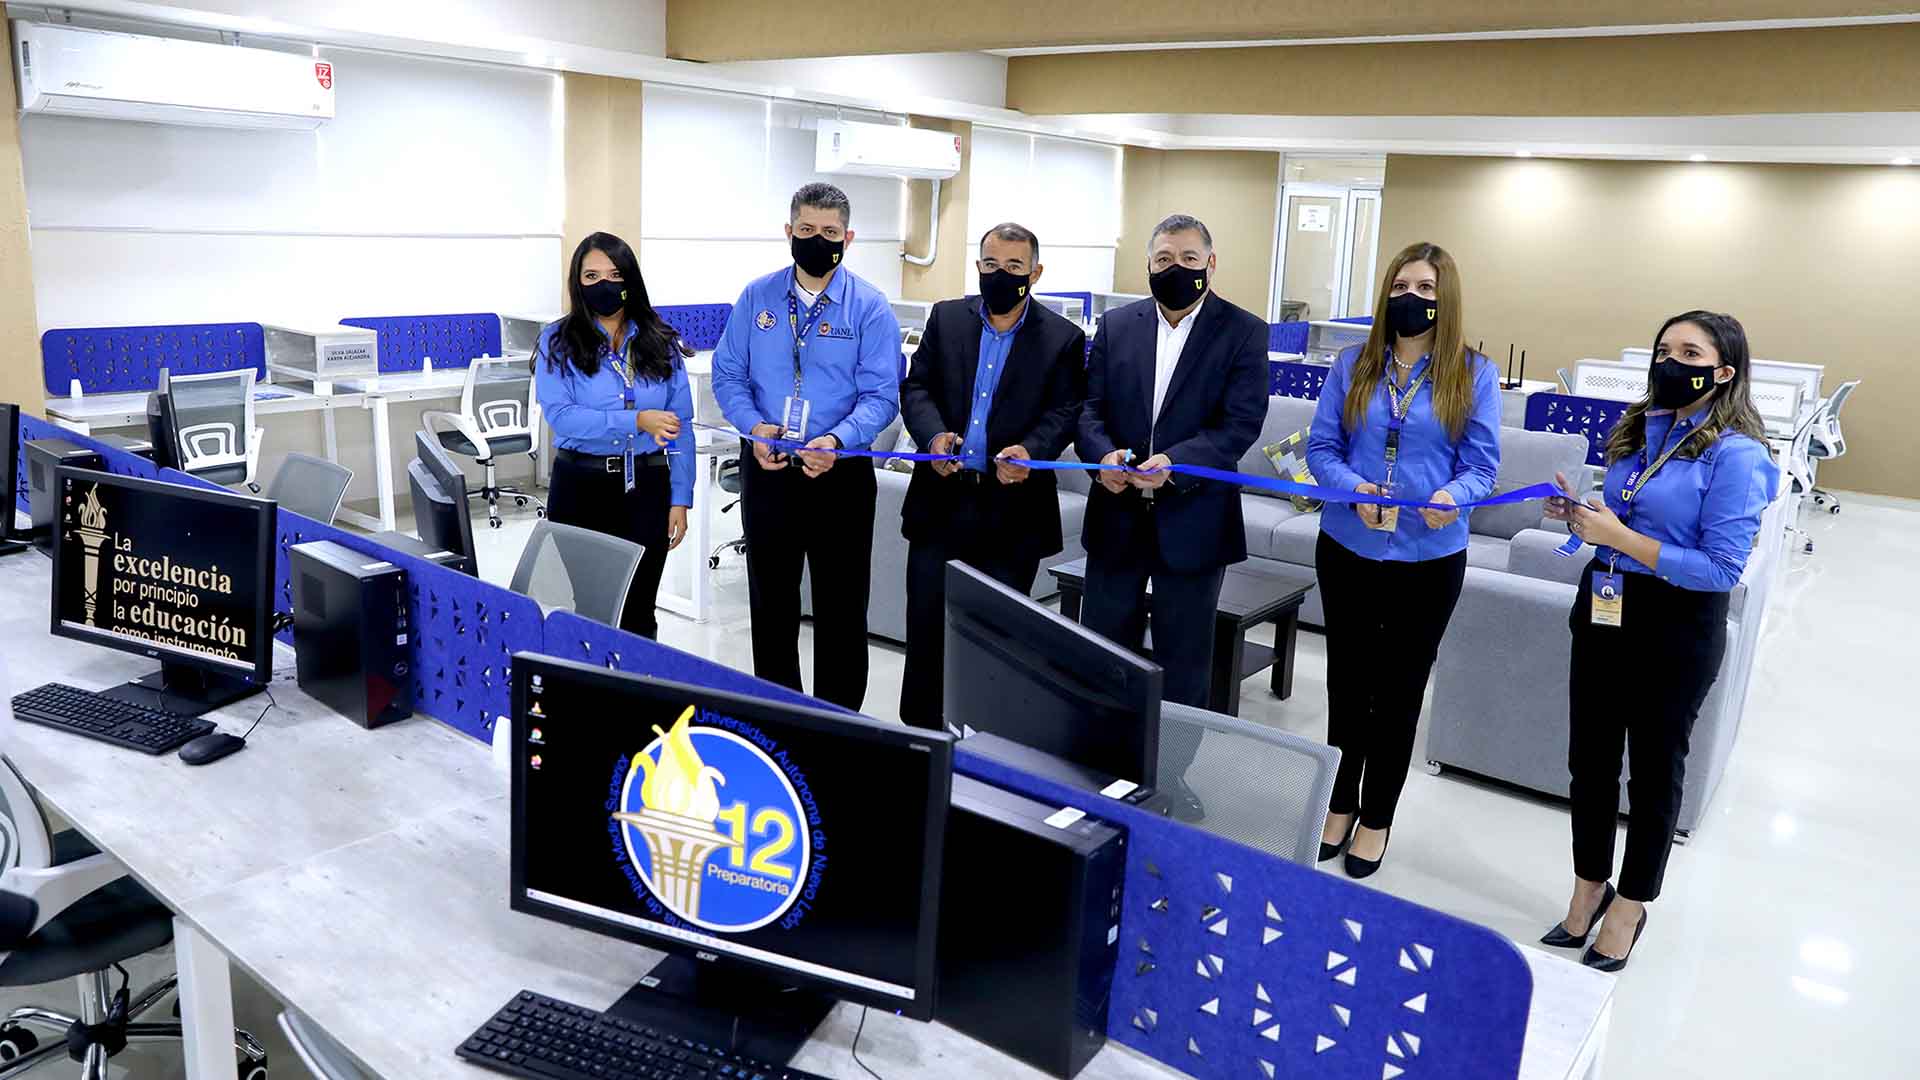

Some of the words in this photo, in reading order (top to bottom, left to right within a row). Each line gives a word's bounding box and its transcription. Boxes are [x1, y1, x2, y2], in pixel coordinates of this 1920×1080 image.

[1690, 376, 1704, 390] U
[114, 531, 132, 552] La
[113, 551, 233, 595] excelencia
[113, 577, 137, 596] por
[139, 582, 199, 609] principio
[113, 599, 126, 621] la
[129, 601, 248, 648] educación
[694, 707, 778, 754] Universidad
[604, 752, 631, 812] Superior
[775, 750, 823, 826] Autónoma
[718, 800, 796, 879] 12
[813, 829, 828, 851] de
[620, 863, 648, 900] Nivel
[707, 863, 790, 897] Preparatoria
[803, 854, 829, 901] Nuevo
[780, 899, 813, 930] León
[695, 950, 720, 962] acer
